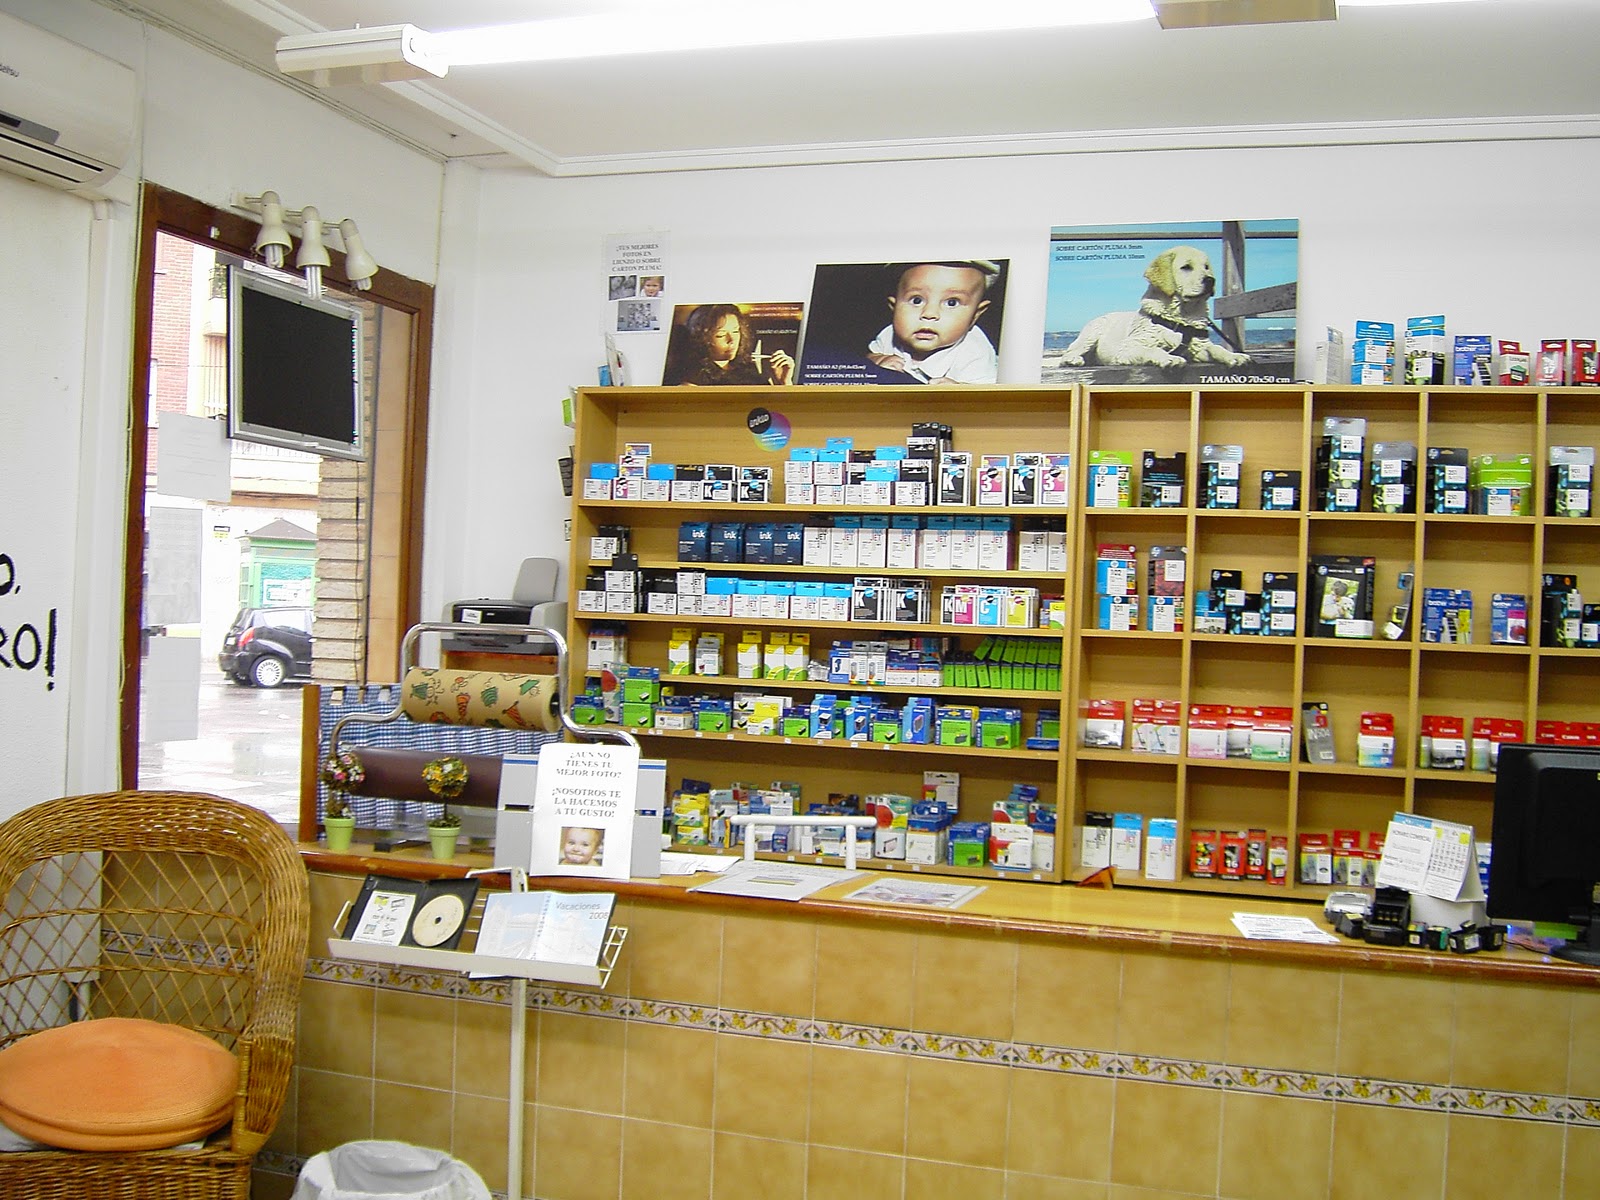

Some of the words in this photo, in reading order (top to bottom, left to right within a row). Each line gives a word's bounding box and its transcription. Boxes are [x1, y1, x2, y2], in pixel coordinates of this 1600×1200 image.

[0, 63, 20, 78] aitsu
[1543, 366, 1556, 374] 17
[1200, 374, 1247, 384] TAMAÑO
[1248, 375, 1275, 384] 70x50
[942, 473, 955, 491] K
[980, 474, 992, 491] 3
[1014, 473, 1026, 491] K
[1043, 474, 1055, 491] 3
[1097, 475, 1105, 483] 15
[705, 485, 713, 498] K
[741, 485, 750, 498] K
[692, 530, 706, 539] ink
[724, 530, 737, 539] ink
[760, 531, 772, 540] ink
[787, 531, 801, 540] ink
[855, 591, 865, 607] K
[896, 593, 906, 609] K
[944, 598, 953, 612] K
[955, 600, 967, 613] M
[602, 761, 614, 769] TU
[556, 768, 589, 777] MEJOR
[591, 770, 622, 779] FOTO?
[552, 787, 607, 798] ¡NOSOTROS
[609, 790, 622, 799] TE
[554, 797, 567, 805] LA
[569, 798, 618, 808] HACEMOS
[564, 808, 577, 816] TU
[579, 808, 615, 818] GUSTO!
[1225, 859, 1239, 868] 16
[556, 902, 601, 911] Vacaciones
